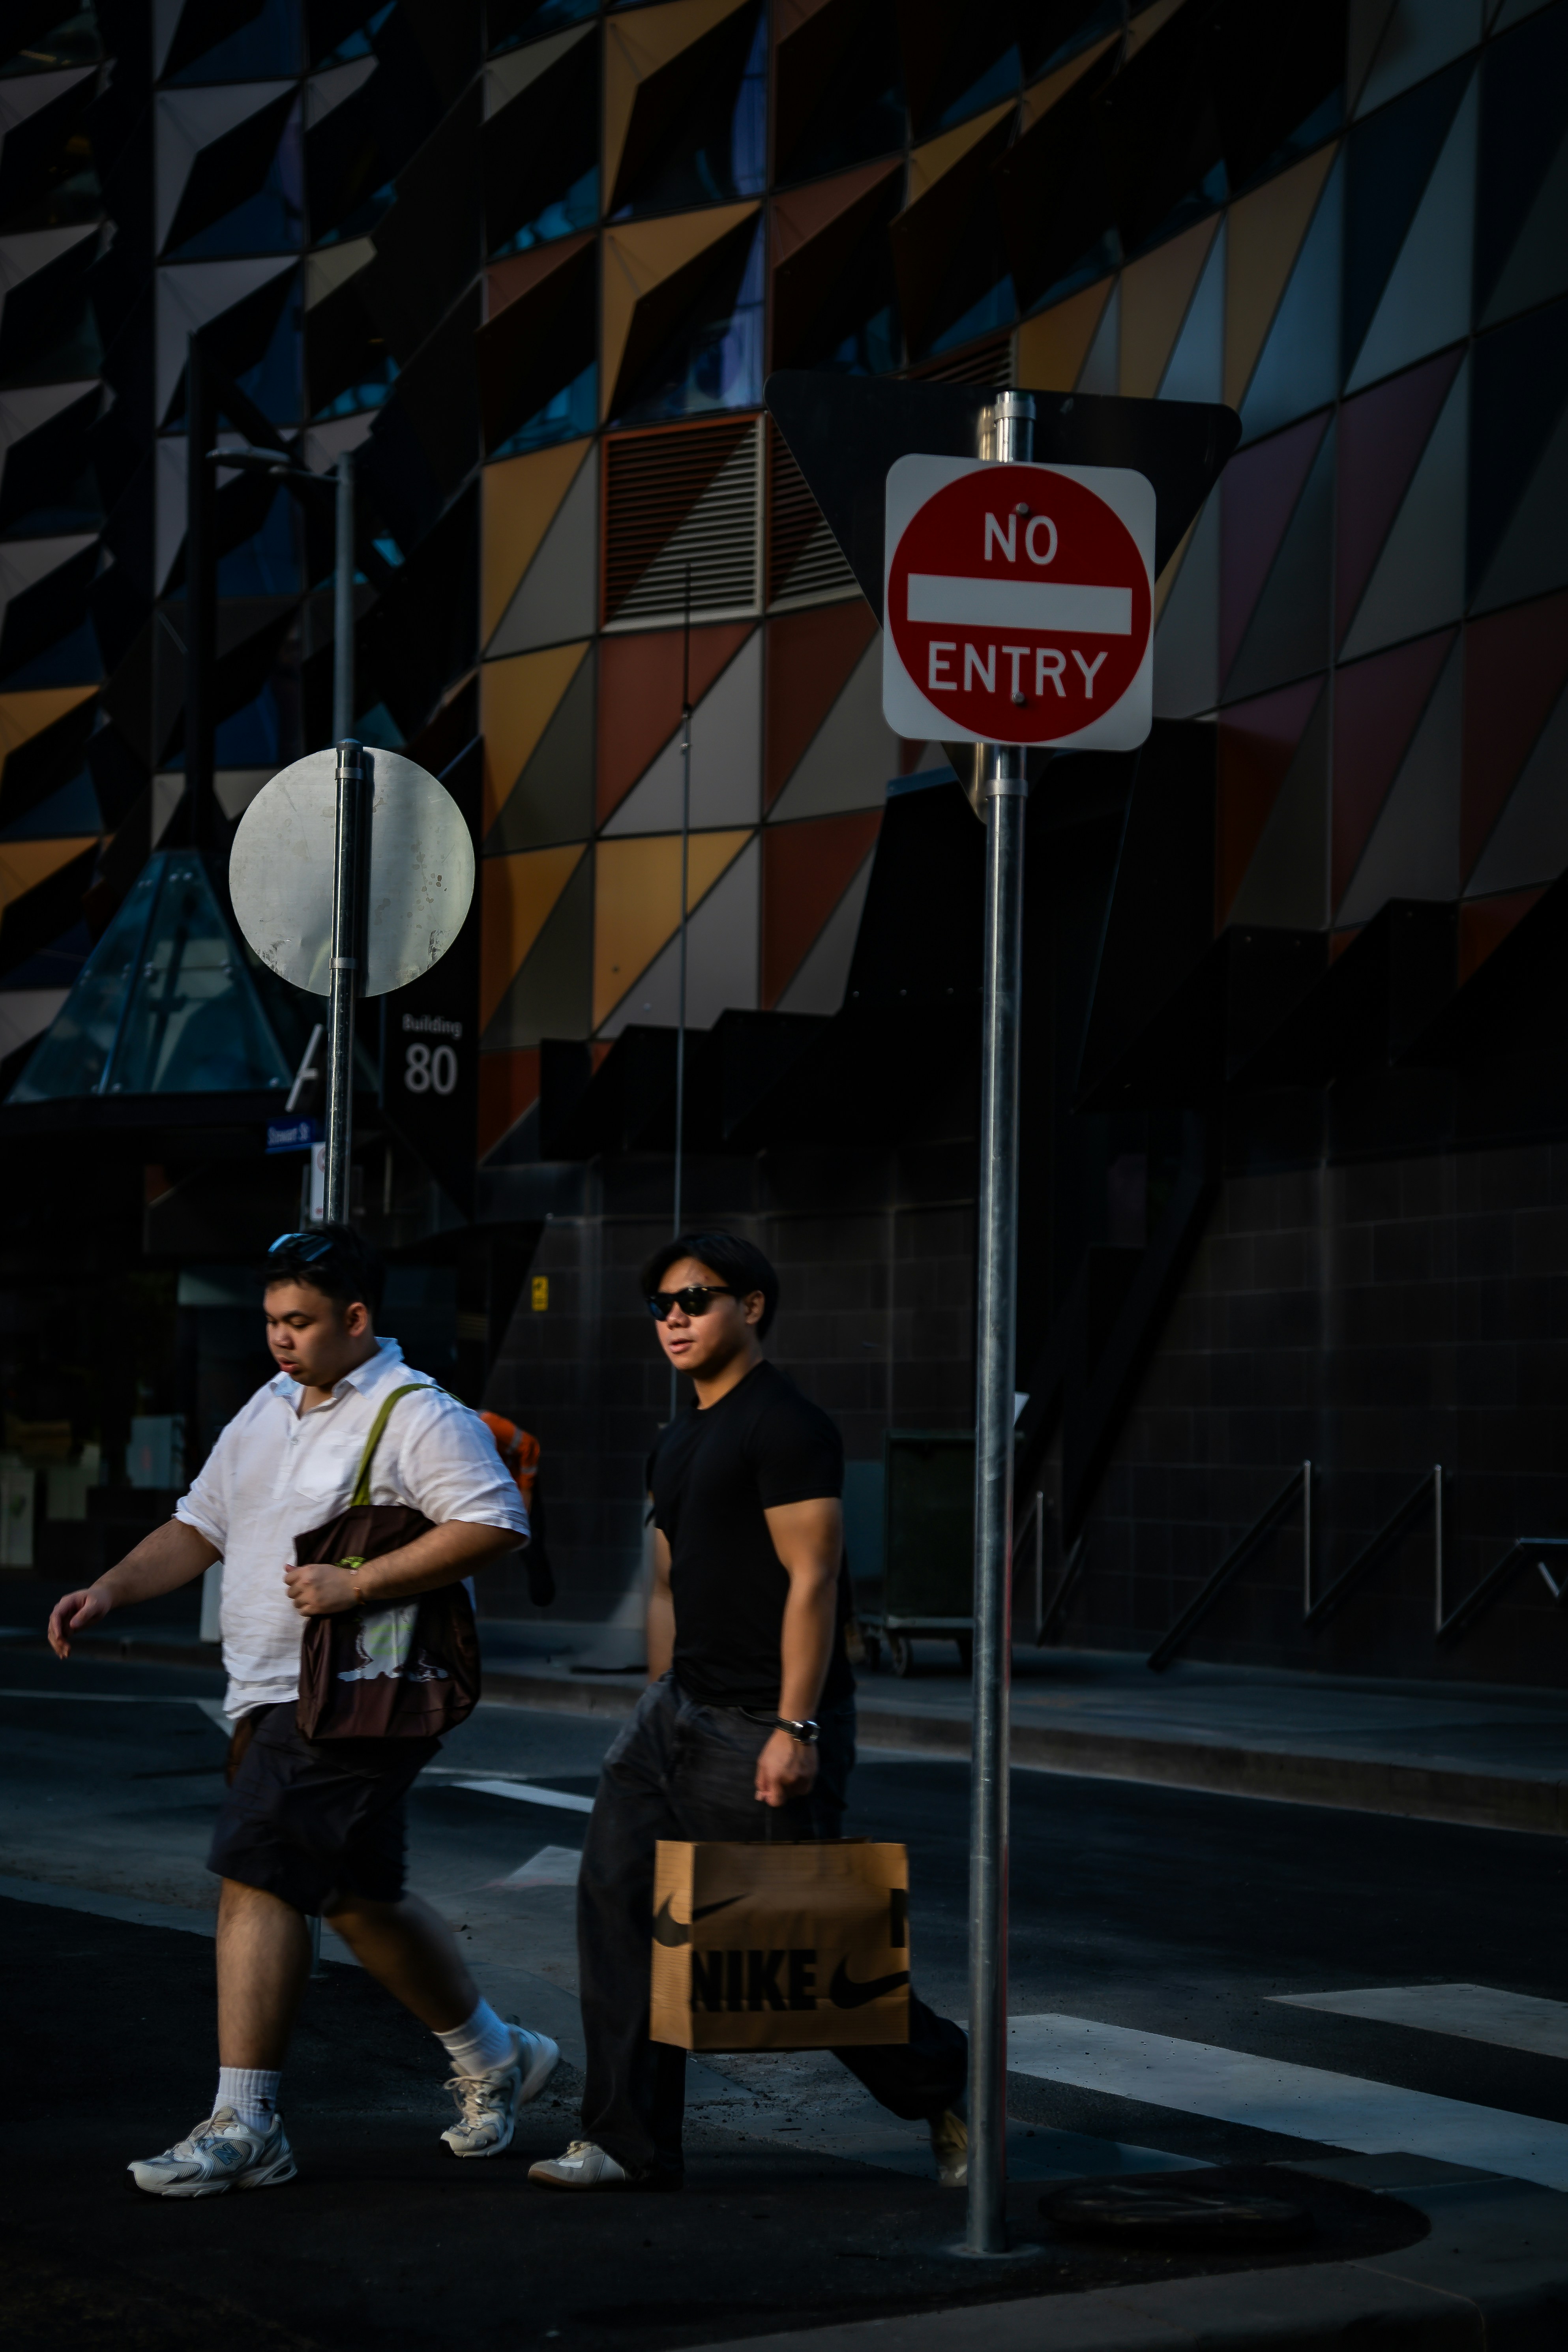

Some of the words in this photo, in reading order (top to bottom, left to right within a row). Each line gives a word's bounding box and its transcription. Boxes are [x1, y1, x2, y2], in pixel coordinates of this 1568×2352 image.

[984, 512, 1058, 566] NO
[928, 640, 1109, 699] ENTRY
[402, 1013, 463, 1040] Building
[404, 1042, 458, 1096] 80
[692, 1949, 816, 2012] NIKE
[214, 2143, 241, 2165] N
